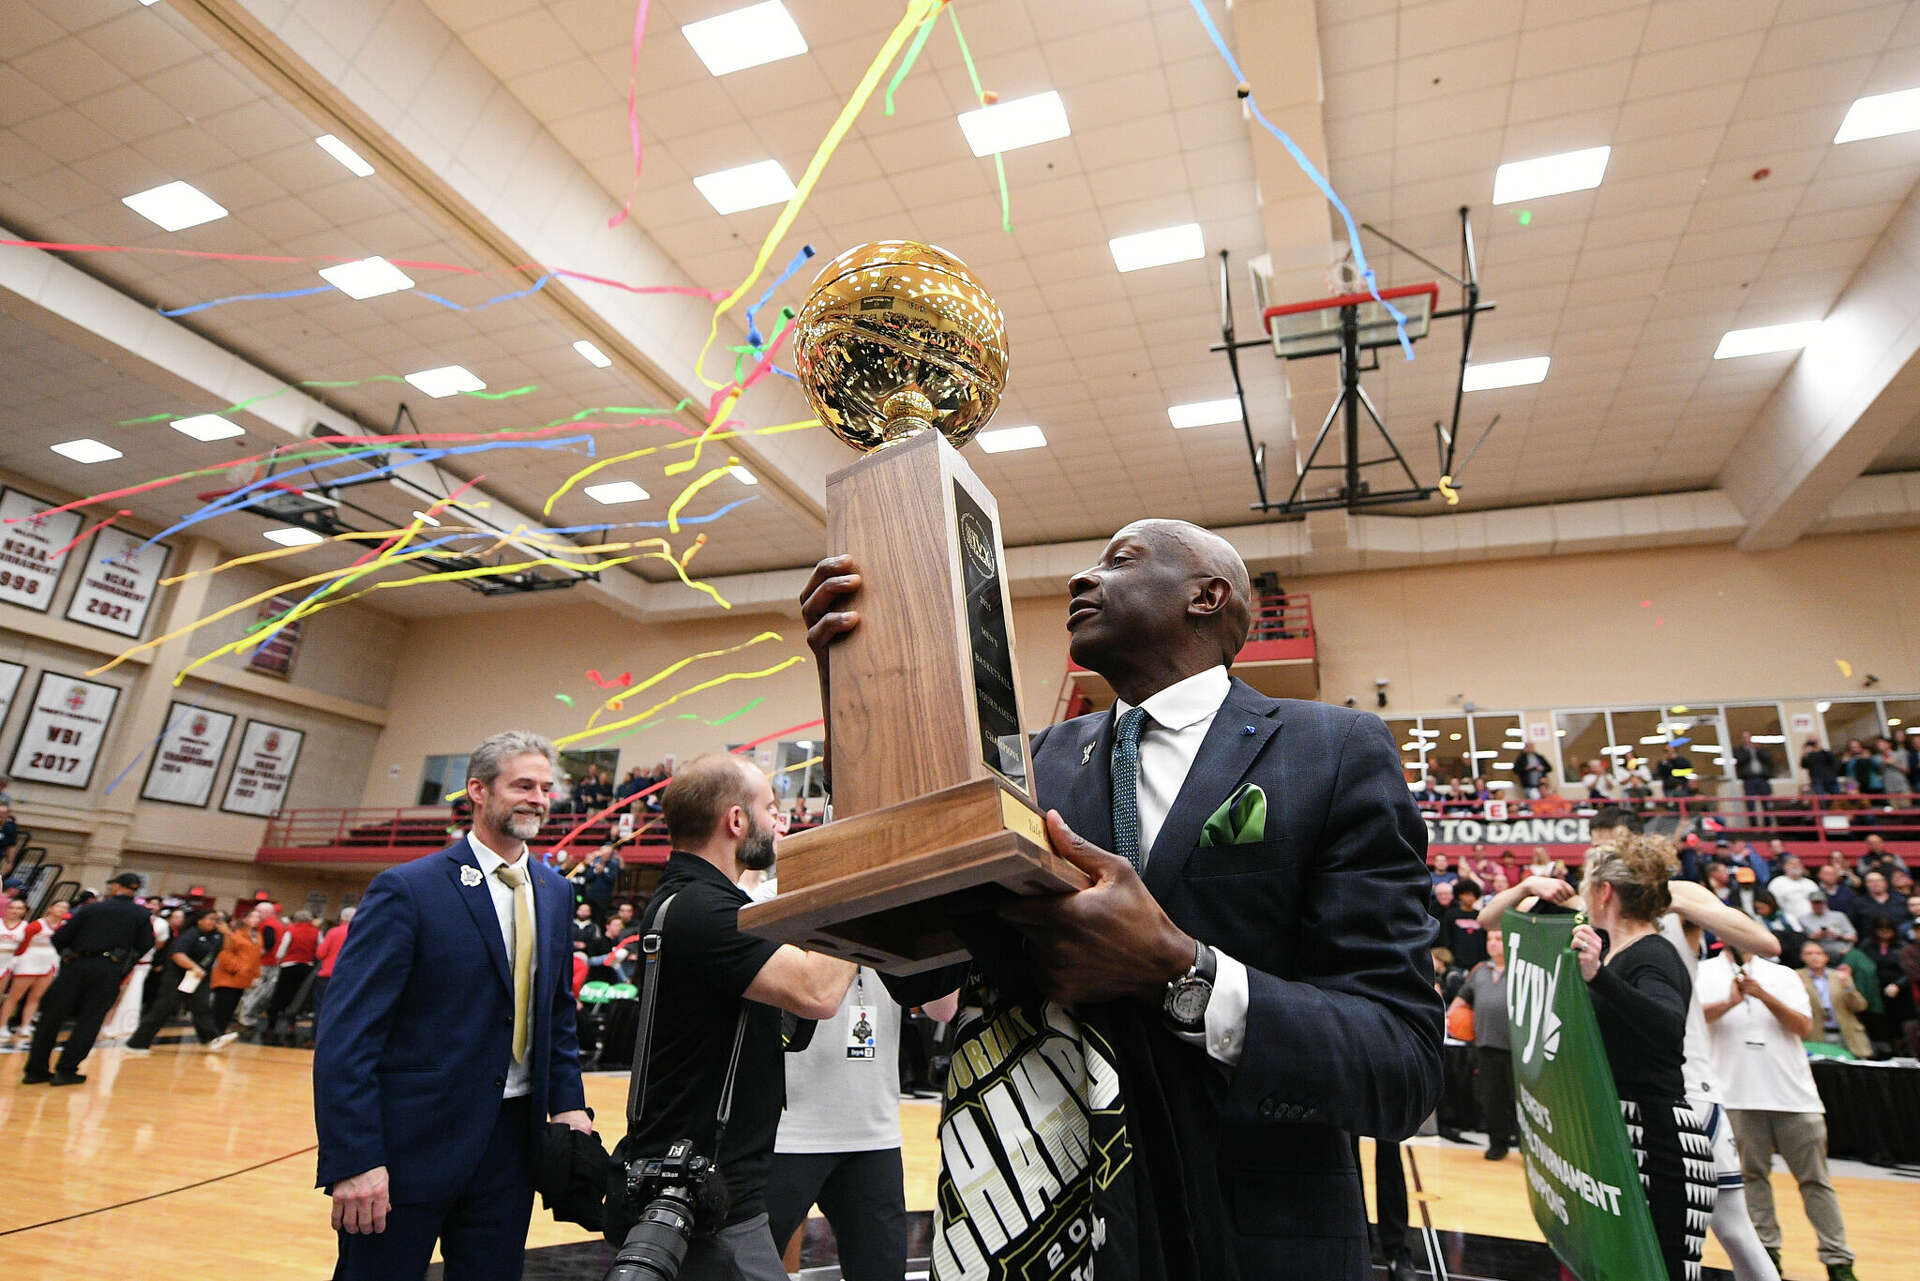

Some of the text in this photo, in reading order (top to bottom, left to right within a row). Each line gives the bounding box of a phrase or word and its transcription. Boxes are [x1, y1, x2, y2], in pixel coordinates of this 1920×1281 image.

[3, 538, 47, 562] NCAA
[0, 571, 39, 595] 998
[86, 598, 133, 623] 2021
[975, 651, 1012, 691] BASKETBALL
[977, 687, 1017, 728] TOURNAMENT
[47, 725, 82, 746] WBI
[984, 730, 1020, 762] CHAMPIONS
[29, 751, 81, 773] 2017
[1438, 820, 1482, 843] TO
